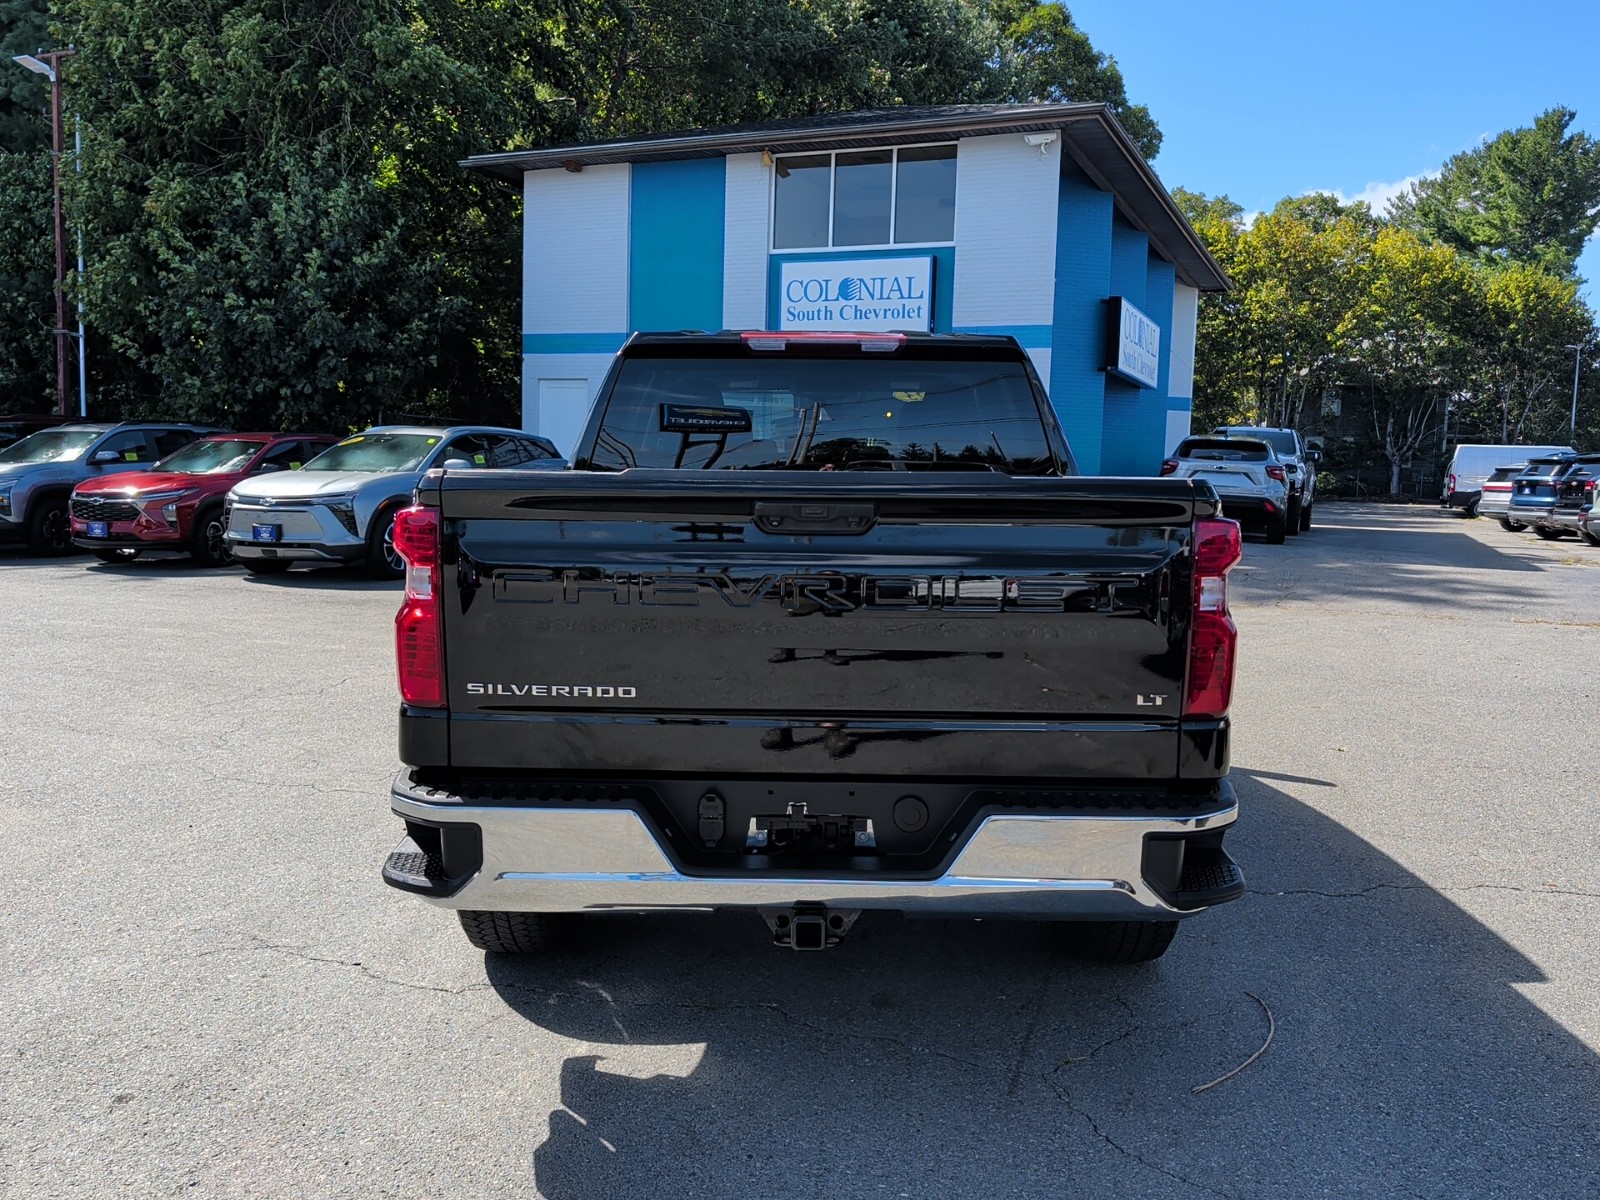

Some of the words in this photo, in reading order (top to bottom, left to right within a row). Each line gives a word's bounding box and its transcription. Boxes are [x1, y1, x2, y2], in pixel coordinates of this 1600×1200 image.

[786, 276, 924, 303] COLONIAL
[786, 305, 833, 322] South
[839, 303, 923, 321] Chevrolet
[492, 568, 1139, 613] CHEVROLET
[466, 683, 637, 698] SILVERADO
[1136, 694, 1168, 706] LT
